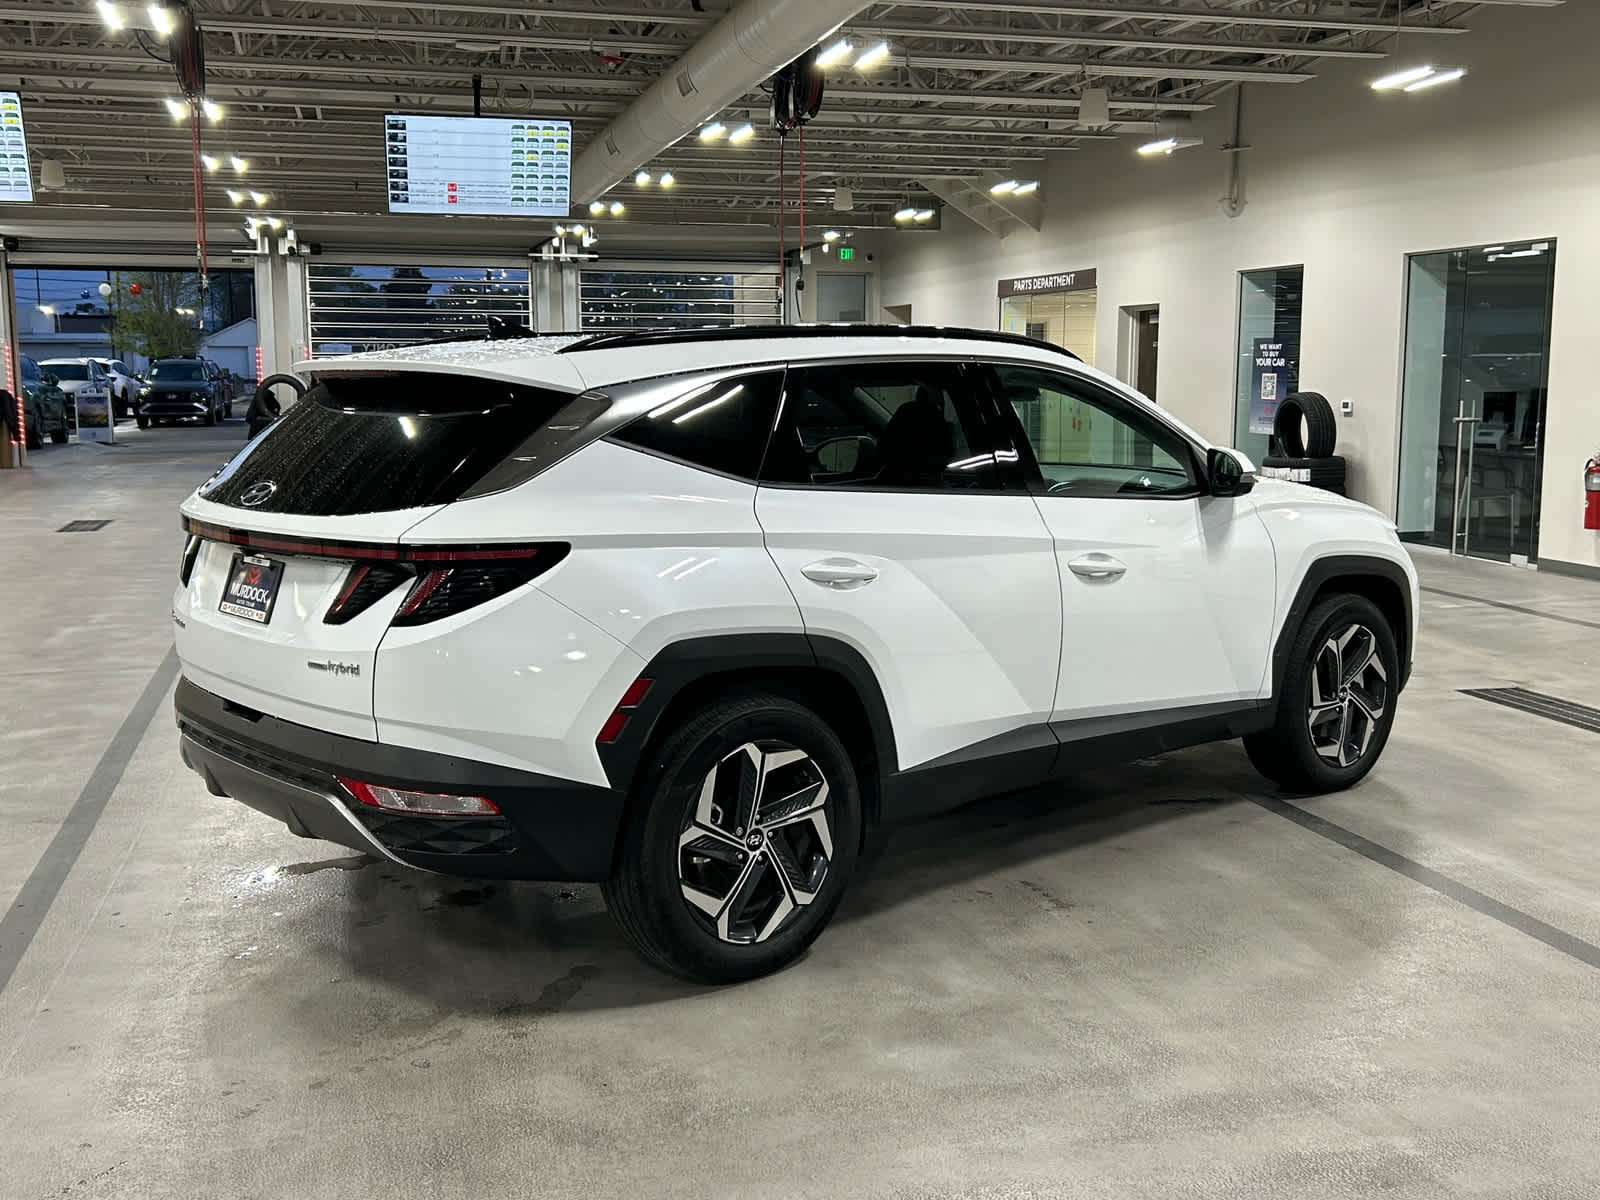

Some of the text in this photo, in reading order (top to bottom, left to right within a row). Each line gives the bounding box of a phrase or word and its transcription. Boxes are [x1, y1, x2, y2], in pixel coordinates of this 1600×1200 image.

[1013, 273, 1076, 291] PARTS DEPARTMENT
[1255, 358, 1286, 367] YOUR CAR
[230, 582, 269, 603] MURDOCK
[328, 660, 360, 677] hybrid
